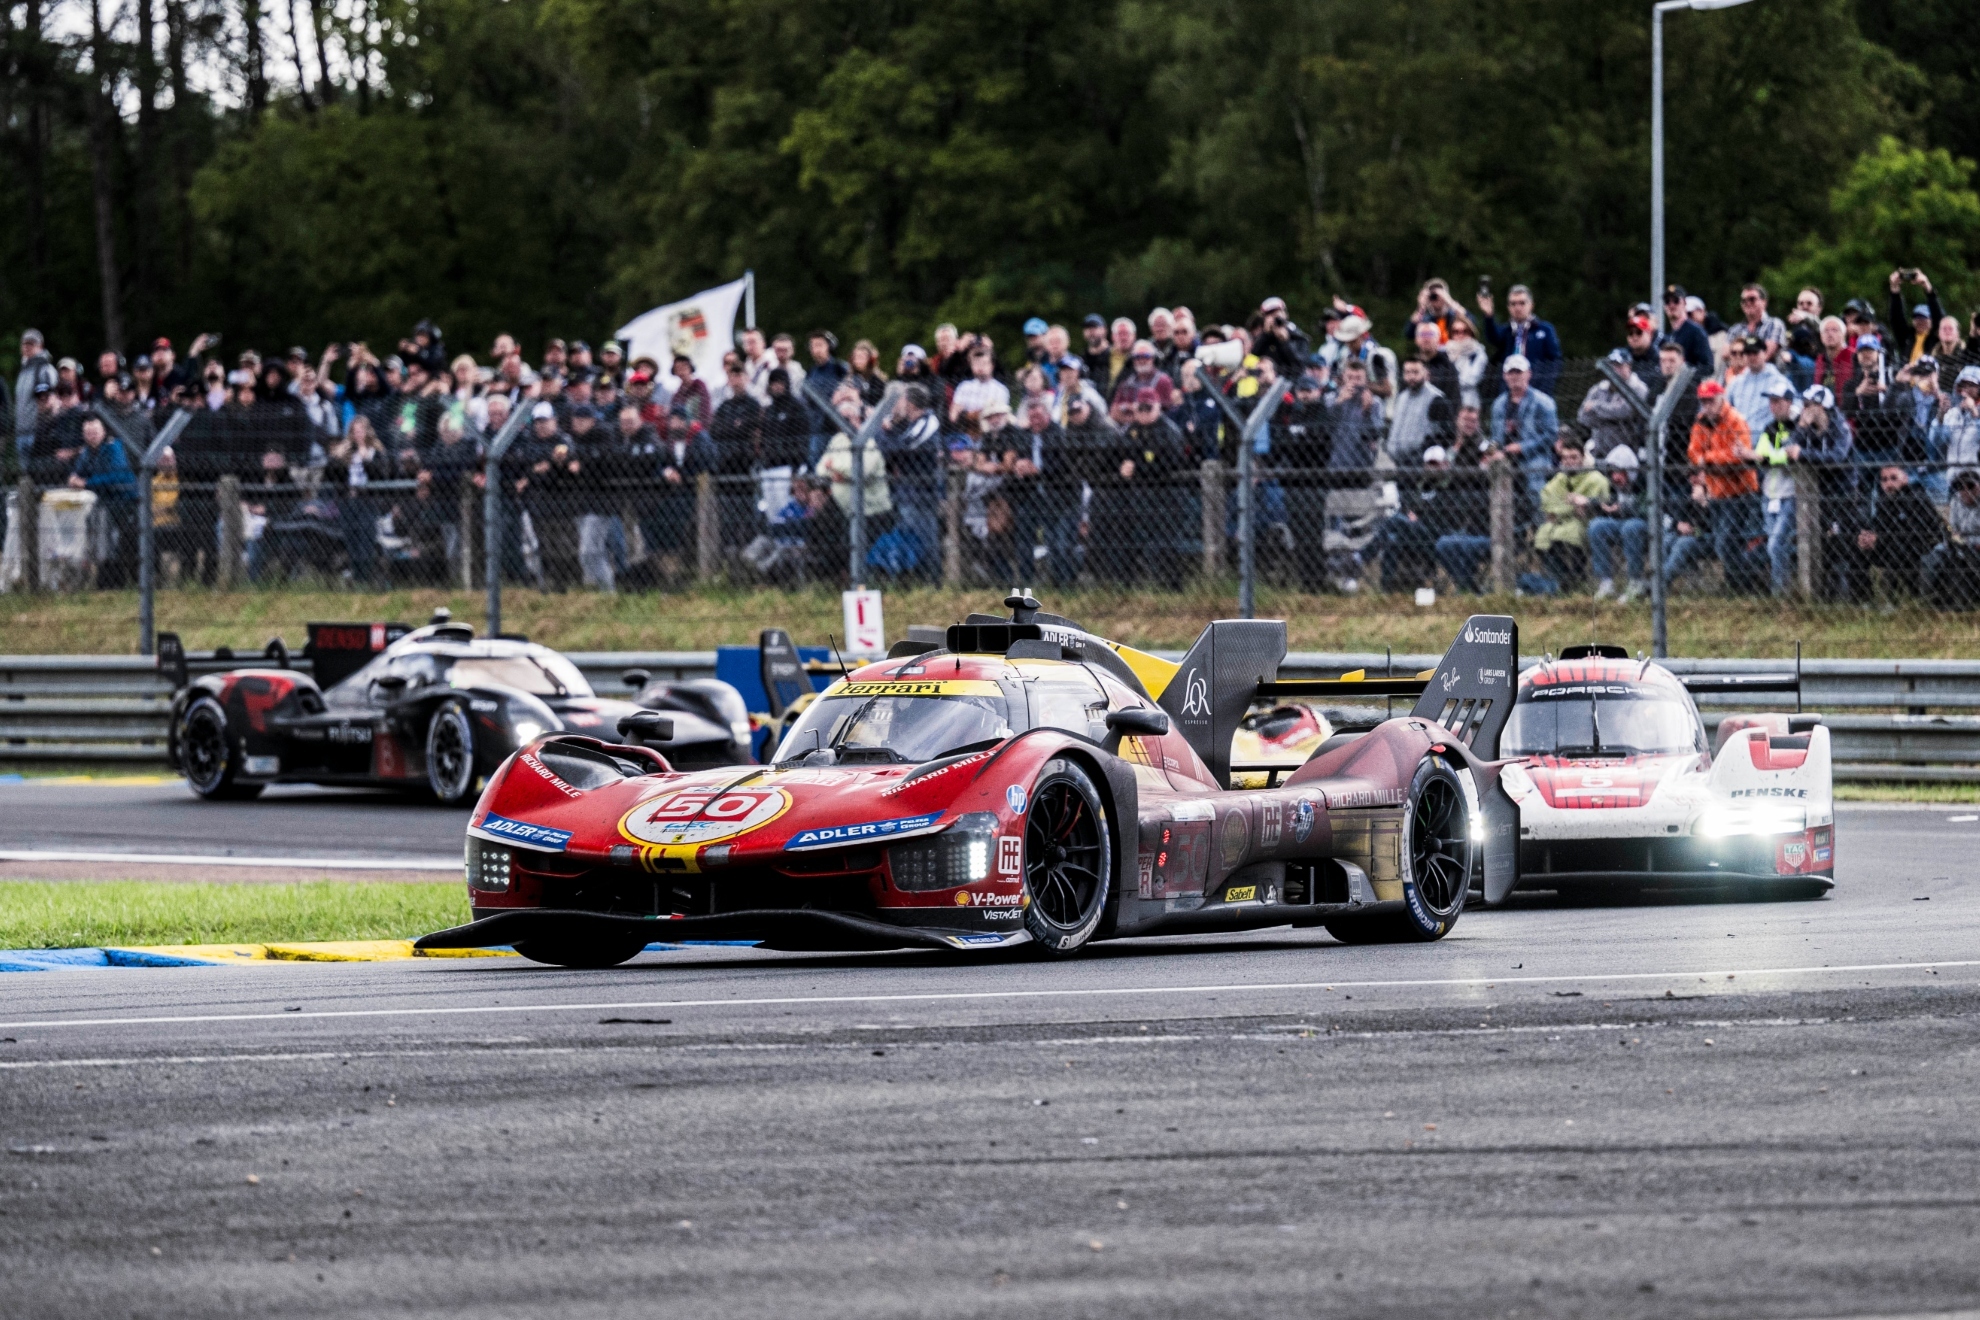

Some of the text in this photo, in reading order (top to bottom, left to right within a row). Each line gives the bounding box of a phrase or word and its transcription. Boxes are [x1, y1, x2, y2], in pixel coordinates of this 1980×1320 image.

[1474, 627, 1512, 645] Santander
[836, 681, 942, 697] Ferrari
[1531, 685, 1658, 698] PORSCHE
[519, 753, 583, 799] RICHARD MILLE
[881, 768, 949, 798] RICHARD
[1010, 789, 1024, 809] hp
[1330, 788, 1403, 807] RICHARD MILLE
[1730, 787, 1809, 799] PENSKE
[656, 795, 758, 818] 50
[483, 820, 539, 837] ADLER
[798, 824, 876, 843] ADLER
[900, 821, 930, 830] GROUP
[1785, 843, 1805, 854] TAG
[1138, 856, 1153, 871] PER
[1173, 834, 1208, 884] 50
[971, 892, 1021, 906] V-Power
[1228, 887, 1253, 901] Sabelt
[1407, 889, 1437, 932] MICHELIN
[1061, 937, 1069, 948] S
